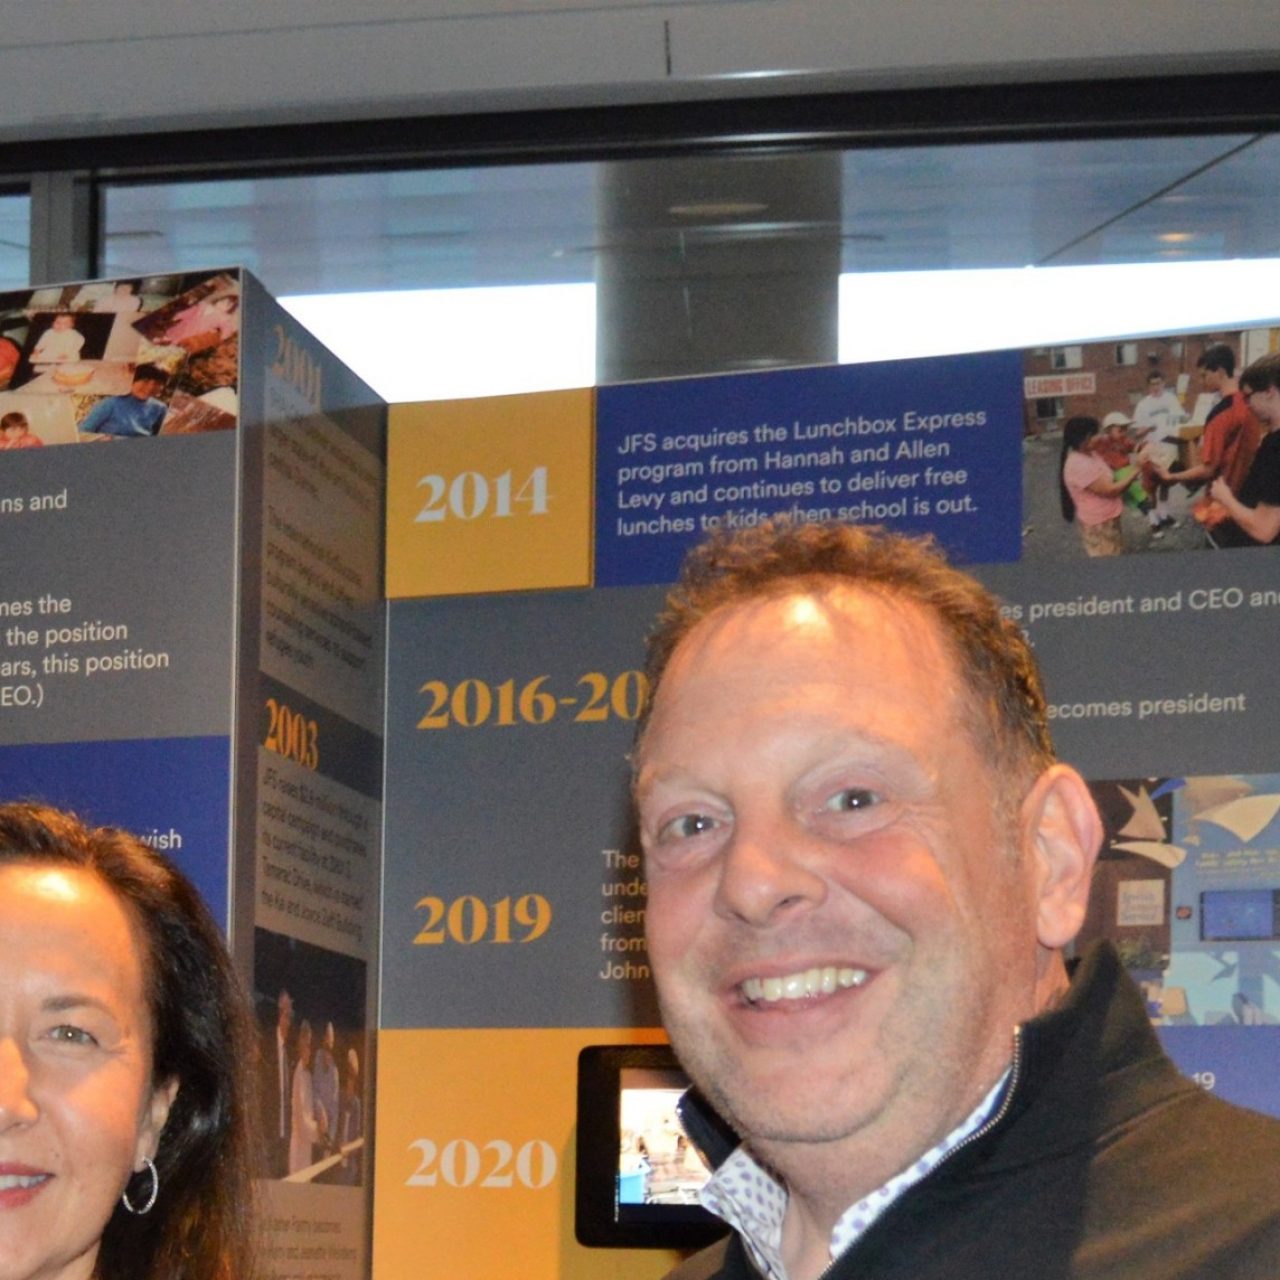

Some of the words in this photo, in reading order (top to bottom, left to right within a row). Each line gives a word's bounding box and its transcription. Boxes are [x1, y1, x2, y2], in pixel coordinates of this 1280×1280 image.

[618, 432, 656, 454] JFS
[662, 427, 748, 452] acquires
[754, 423, 787, 443] the
[794, 416, 896, 440] Lunchbox
[903, 410, 986, 433] Express
[618, 461, 703, 485] program
[710, 454, 758, 474] from
[765, 445, 844, 470] Hannah
[850, 442, 889, 463] and
[895, 438, 949, 459] Allen
[30, 487, 67, 511] and
[414, 466, 551, 524] 2014
[618, 490, 665, 510] Levy
[670, 483, 708, 506] and
[714, 479, 814, 502] continues
[820, 476, 841, 494] to
[847, 469, 919, 492] deliver
[925, 466, 967, 486] free
[617, 514, 694, 536] lunches
[700, 513, 721, 532] to
[837, 497, 908, 522] school
[913, 493, 931, 515] is
[936, 491, 978, 514] out.
[38, 594, 71, 614] the
[1029, 595, 1134, 623] president
[1140, 591, 1182, 613] and
[1189, 587, 1243, 610] CEO
[6, 625, 38, 646] the
[45, 620, 127, 649] position
[43, 652, 79, 674] this
[86, 648, 169, 676] position
[1045, 699, 1132, 720] ecomes
[1139, 692, 1245, 720] president
[265, 699, 318, 771] 2003
[601, 849, 639, 868] The
[413, 894, 552, 945] 2019
[600, 960, 650, 979] John
[405, 1138, 557, 1189] 2020
